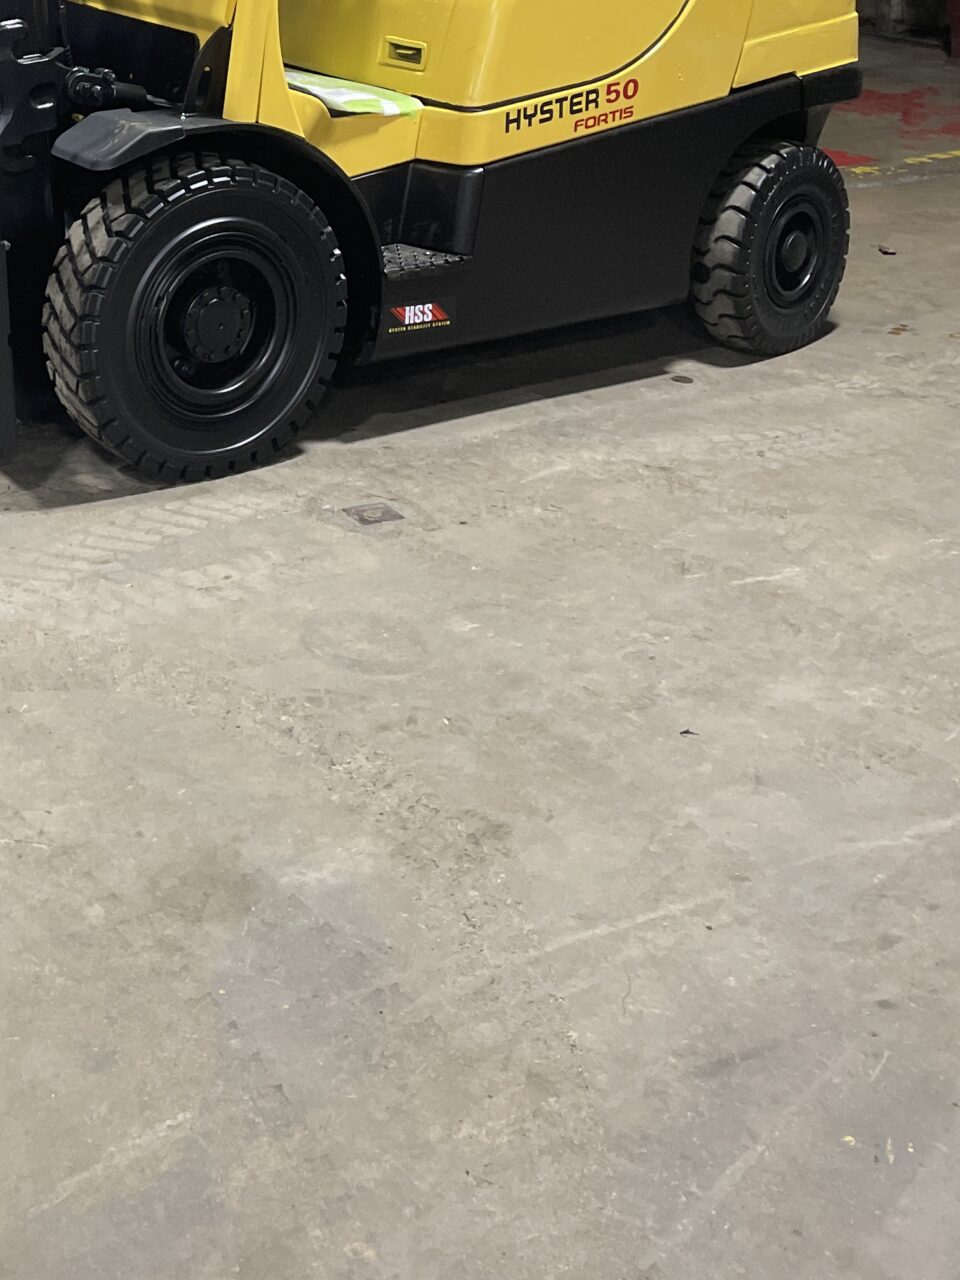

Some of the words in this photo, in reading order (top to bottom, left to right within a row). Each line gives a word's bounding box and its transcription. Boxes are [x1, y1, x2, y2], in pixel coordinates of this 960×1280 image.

[505, 88, 600, 133] HYSTER
[605, 78, 639, 104] 50
[574, 106, 634, 132] FORTIS
[404, 303, 433, 325] HSS
